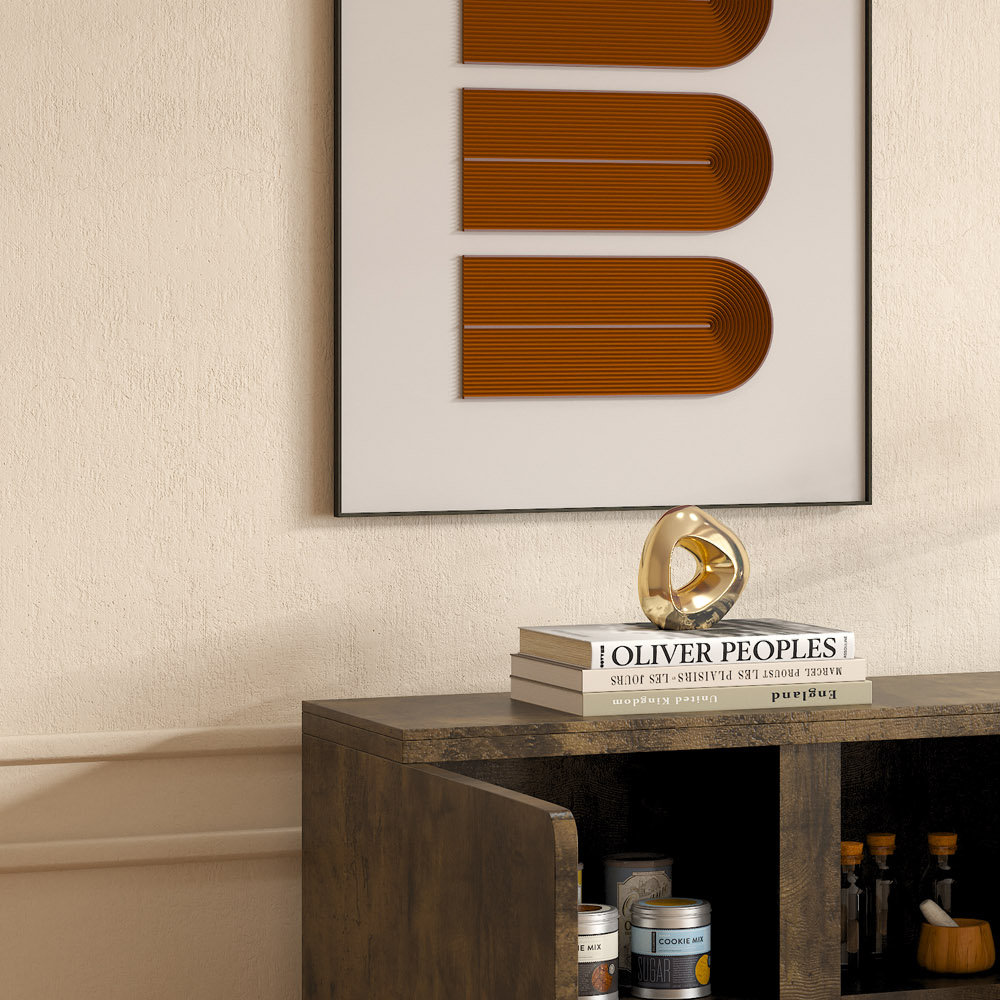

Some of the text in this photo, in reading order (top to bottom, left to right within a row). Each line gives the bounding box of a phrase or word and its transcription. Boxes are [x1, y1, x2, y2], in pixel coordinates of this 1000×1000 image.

[611, 642, 713, 667] OLIVER
[720, 637, 837, 662] PEOPLES
[738, 669, 758, 680] LES
[763, 668, 800, 679] PROUST
[804, 666, 843, 677] MARCEL
[610, 675, 645, 686] JOURS
[649, 673, 669, 684] LES
[612, 695, 718, 707] United Kingdom
[771, 688, 837, 703] England
[637, 956, 671, 983] SUGAR
